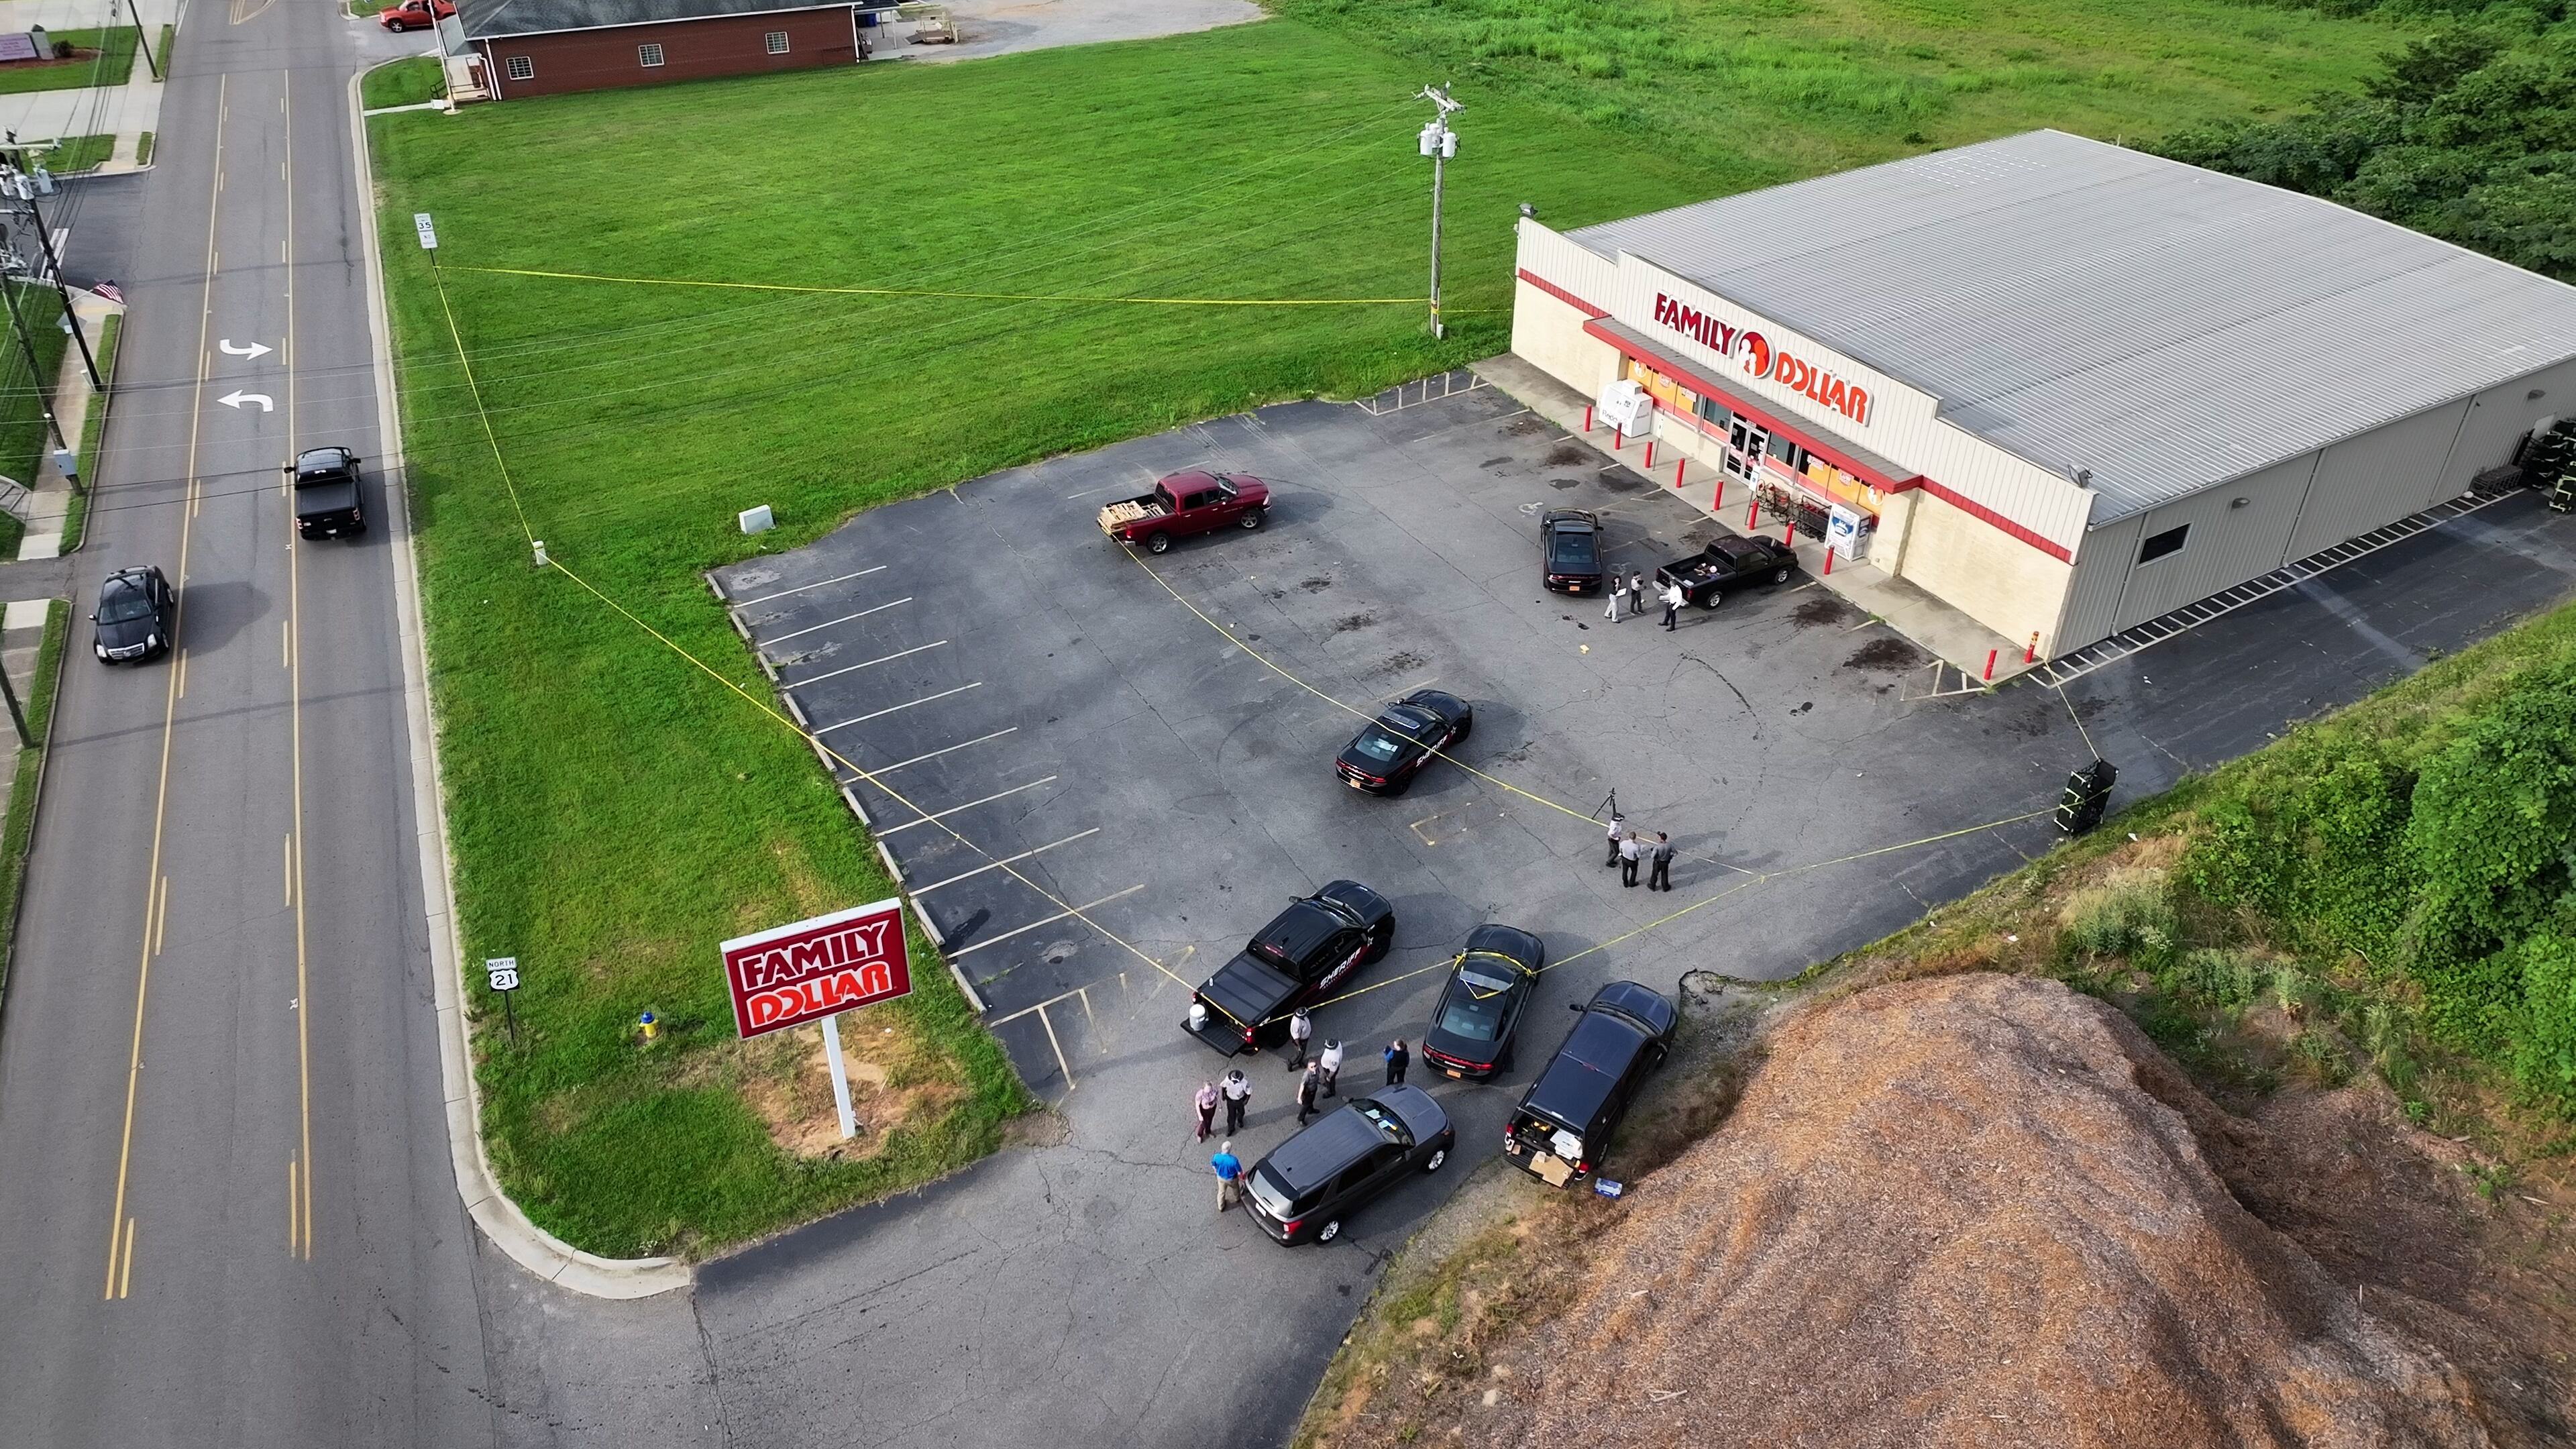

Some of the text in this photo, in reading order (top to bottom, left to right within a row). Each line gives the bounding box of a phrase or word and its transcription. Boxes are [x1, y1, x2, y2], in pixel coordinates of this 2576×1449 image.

[1654, 292, 1869, 425] FAMILY DOLLAR
[1415, 735, 1448, 767] SHERIFF
[495, 973, 513, 986] 21
[740, 920, 888, 991] FAMILY
[1319, 947, 1361, 989] SHERIFF
[748, 961, 892, 1027] DOLLAR
